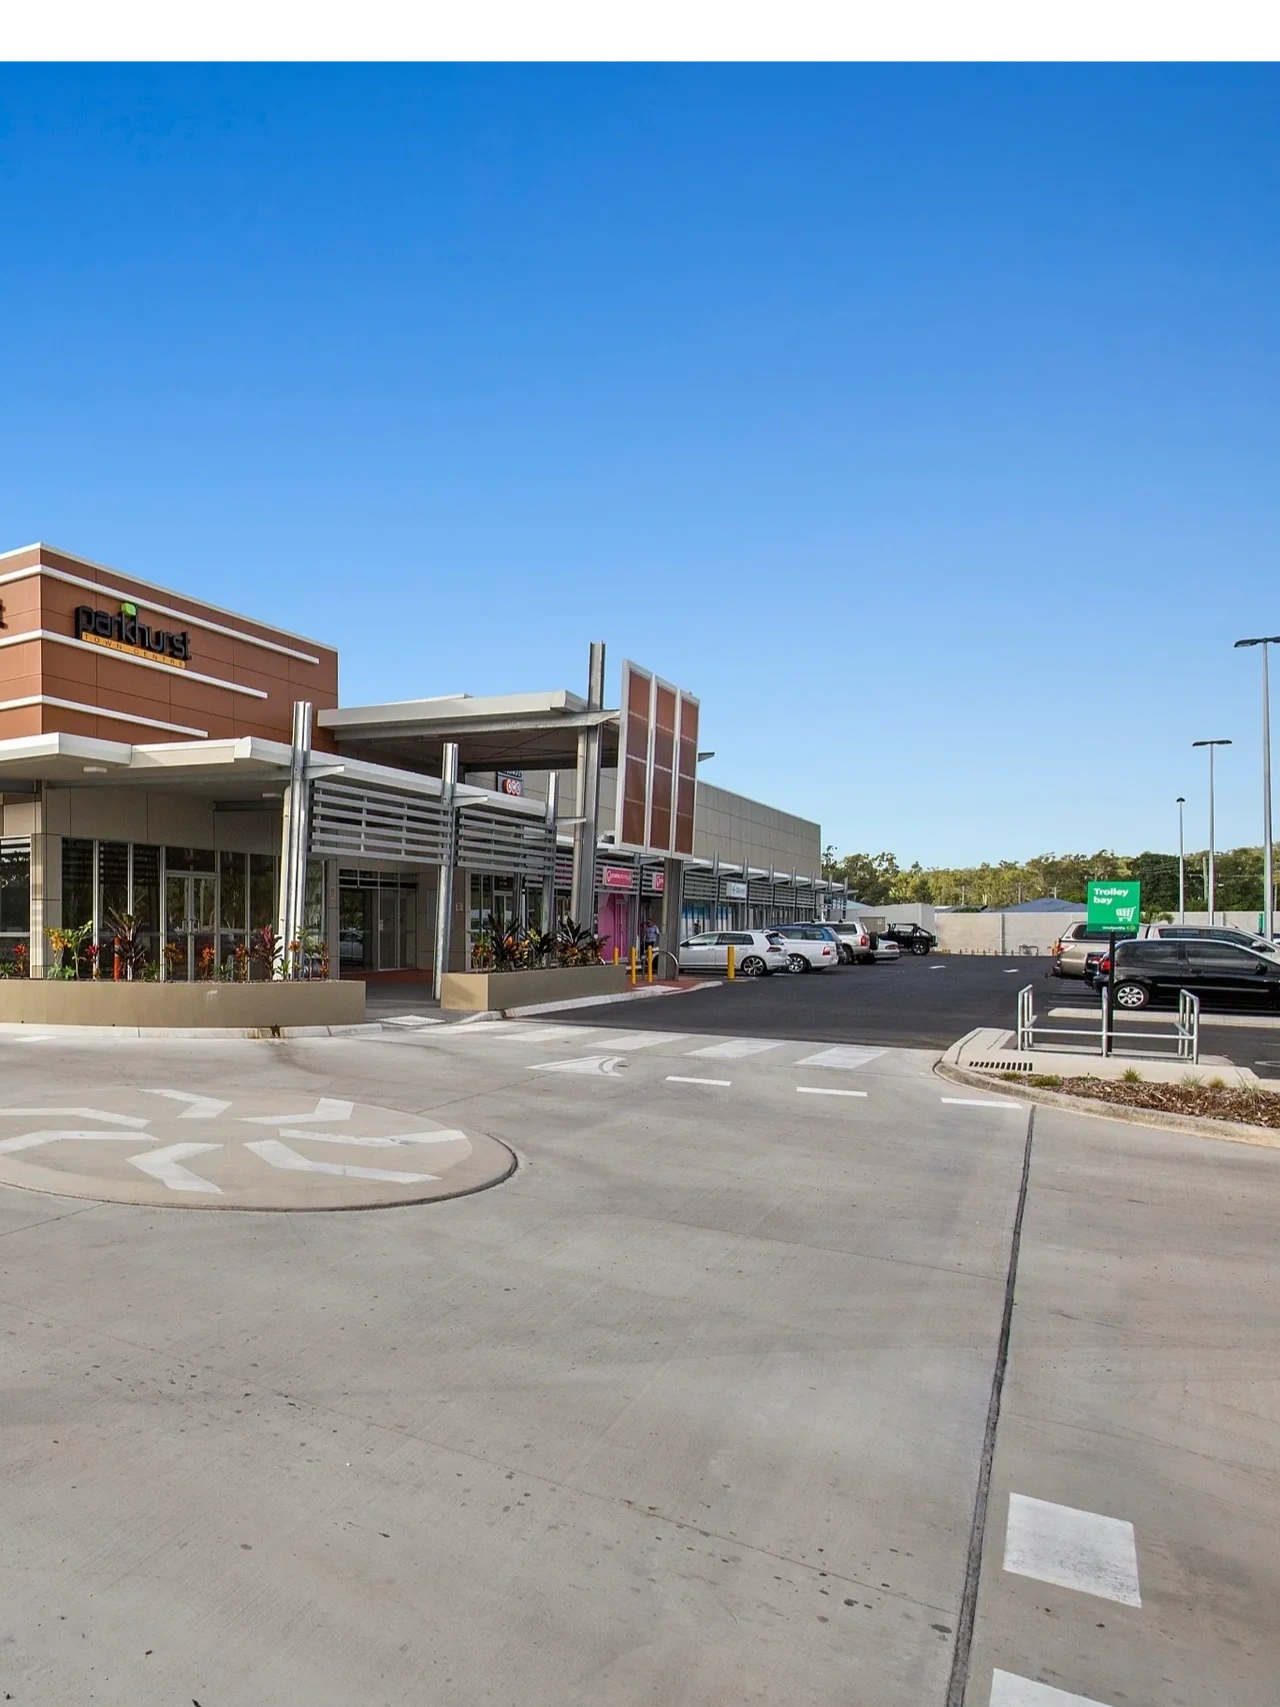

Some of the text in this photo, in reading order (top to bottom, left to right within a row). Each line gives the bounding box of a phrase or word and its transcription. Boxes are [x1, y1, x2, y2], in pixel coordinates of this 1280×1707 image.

[75, 602, 192, 661] parkhurst
[84, 632, 184, 668] TOWN CENTRE
[1093, 887, 1129, 898] Trolley
[1093, 896, 1113, 906] bay
